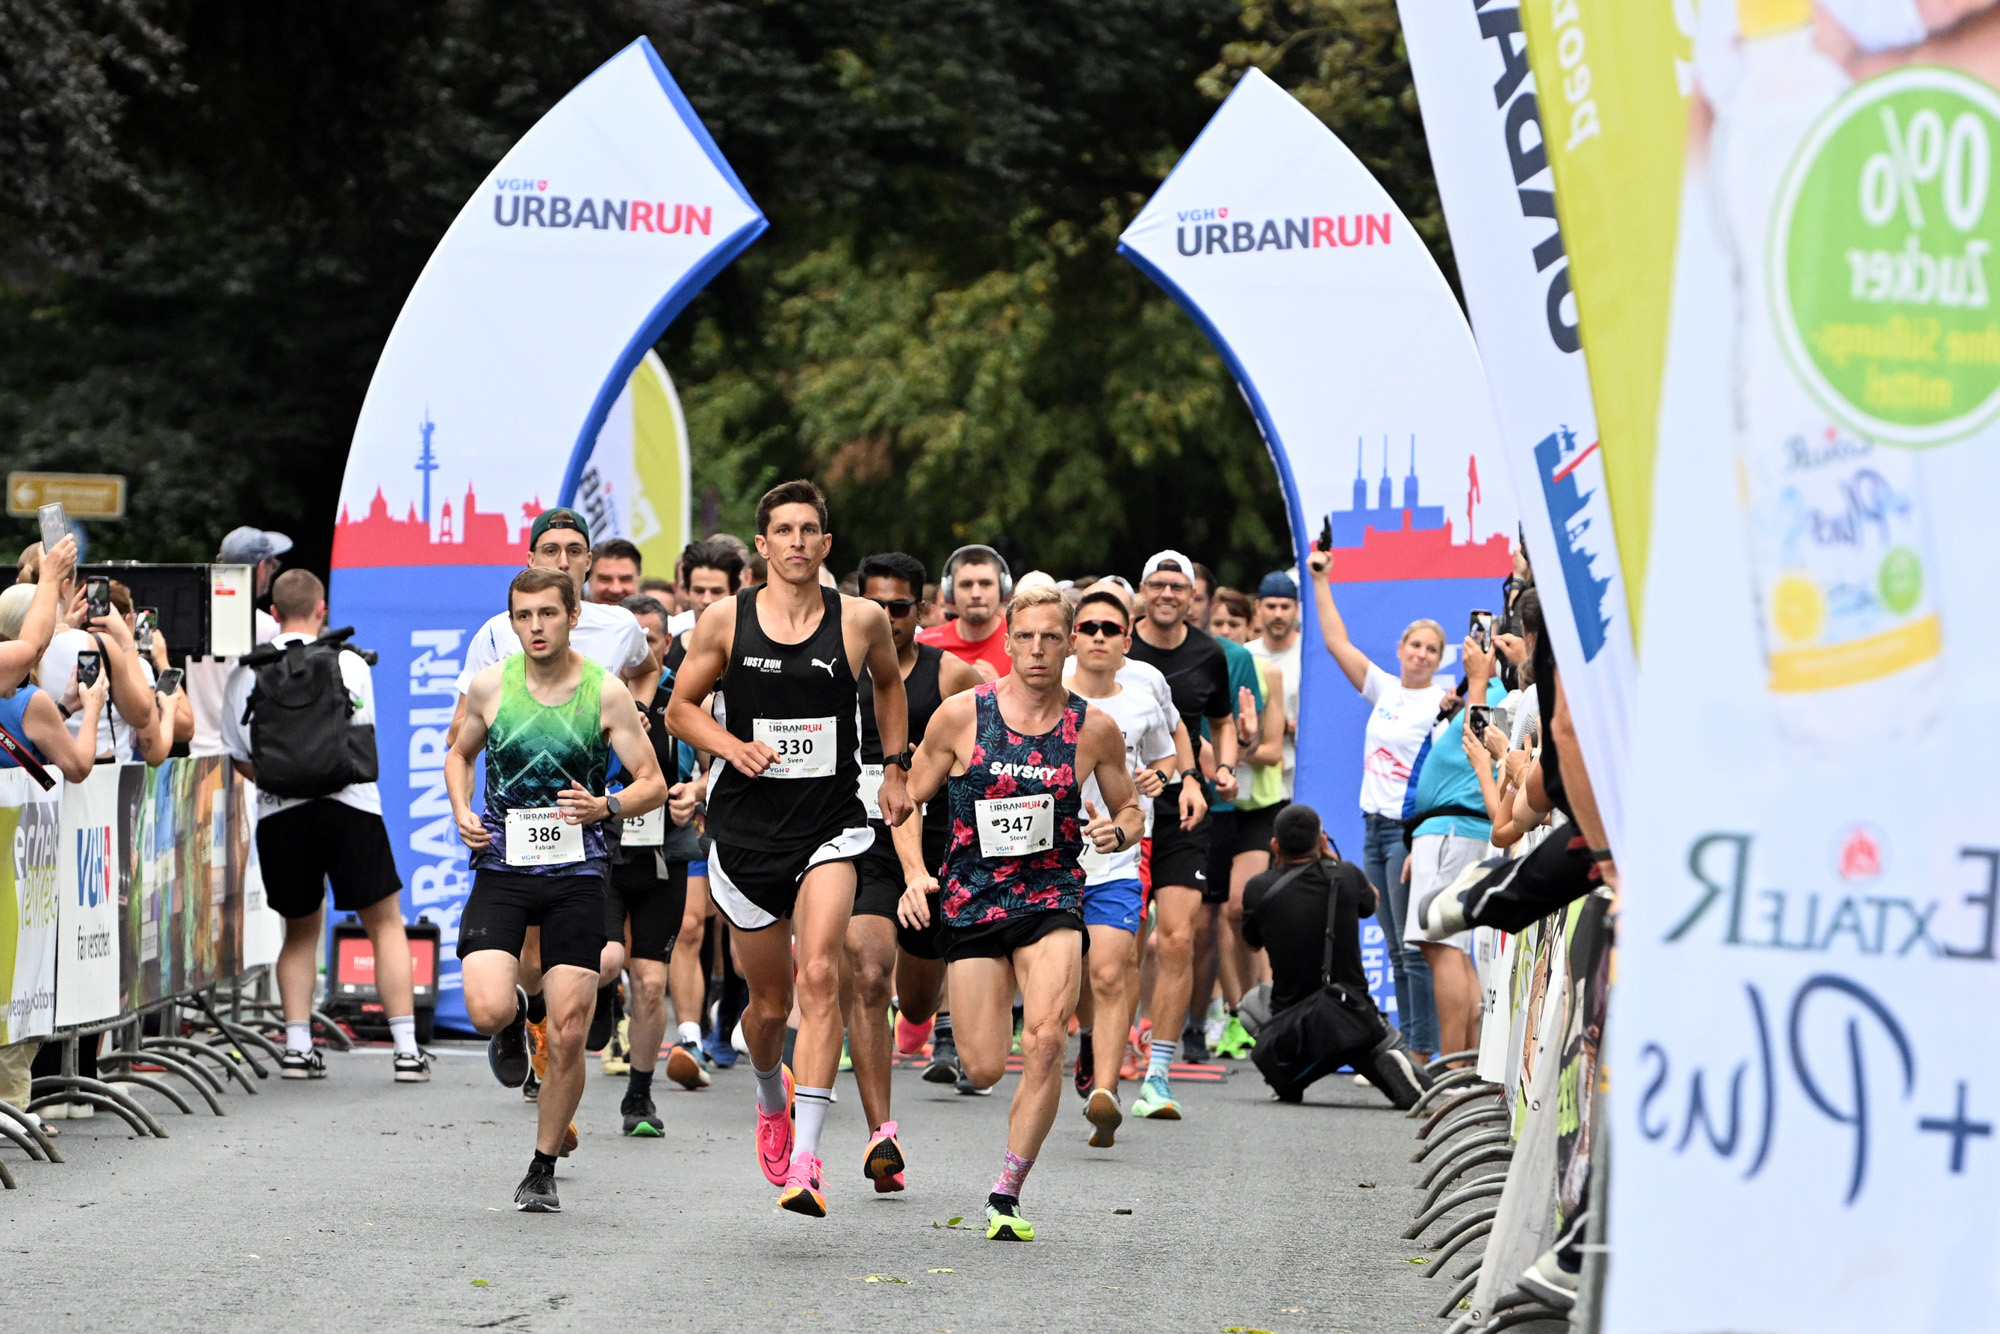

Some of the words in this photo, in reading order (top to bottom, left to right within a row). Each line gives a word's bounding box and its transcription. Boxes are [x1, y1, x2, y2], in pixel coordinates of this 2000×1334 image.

[496, 179, 534, 190] VGH
[494, 195, 712, 235] URBANRUN
[1177, 208, 1215, 222] VGH
[1177, 213, 1392, 257] URBANRUN
[743, 656, 763, 668] JUST
[763, 658, 782, 669] RUN
[769, 723, 822, 733] URBANRUN
[778, 739, 813, 755] 330
[989, 761, 1058, 780] SAYSKY
[989, 800, 1041, 812] URBANRUN
[1000, 816, 1033, 833] 347
[528, 826, 561, 842] 386
[77, 827, 104, 907] VGH
